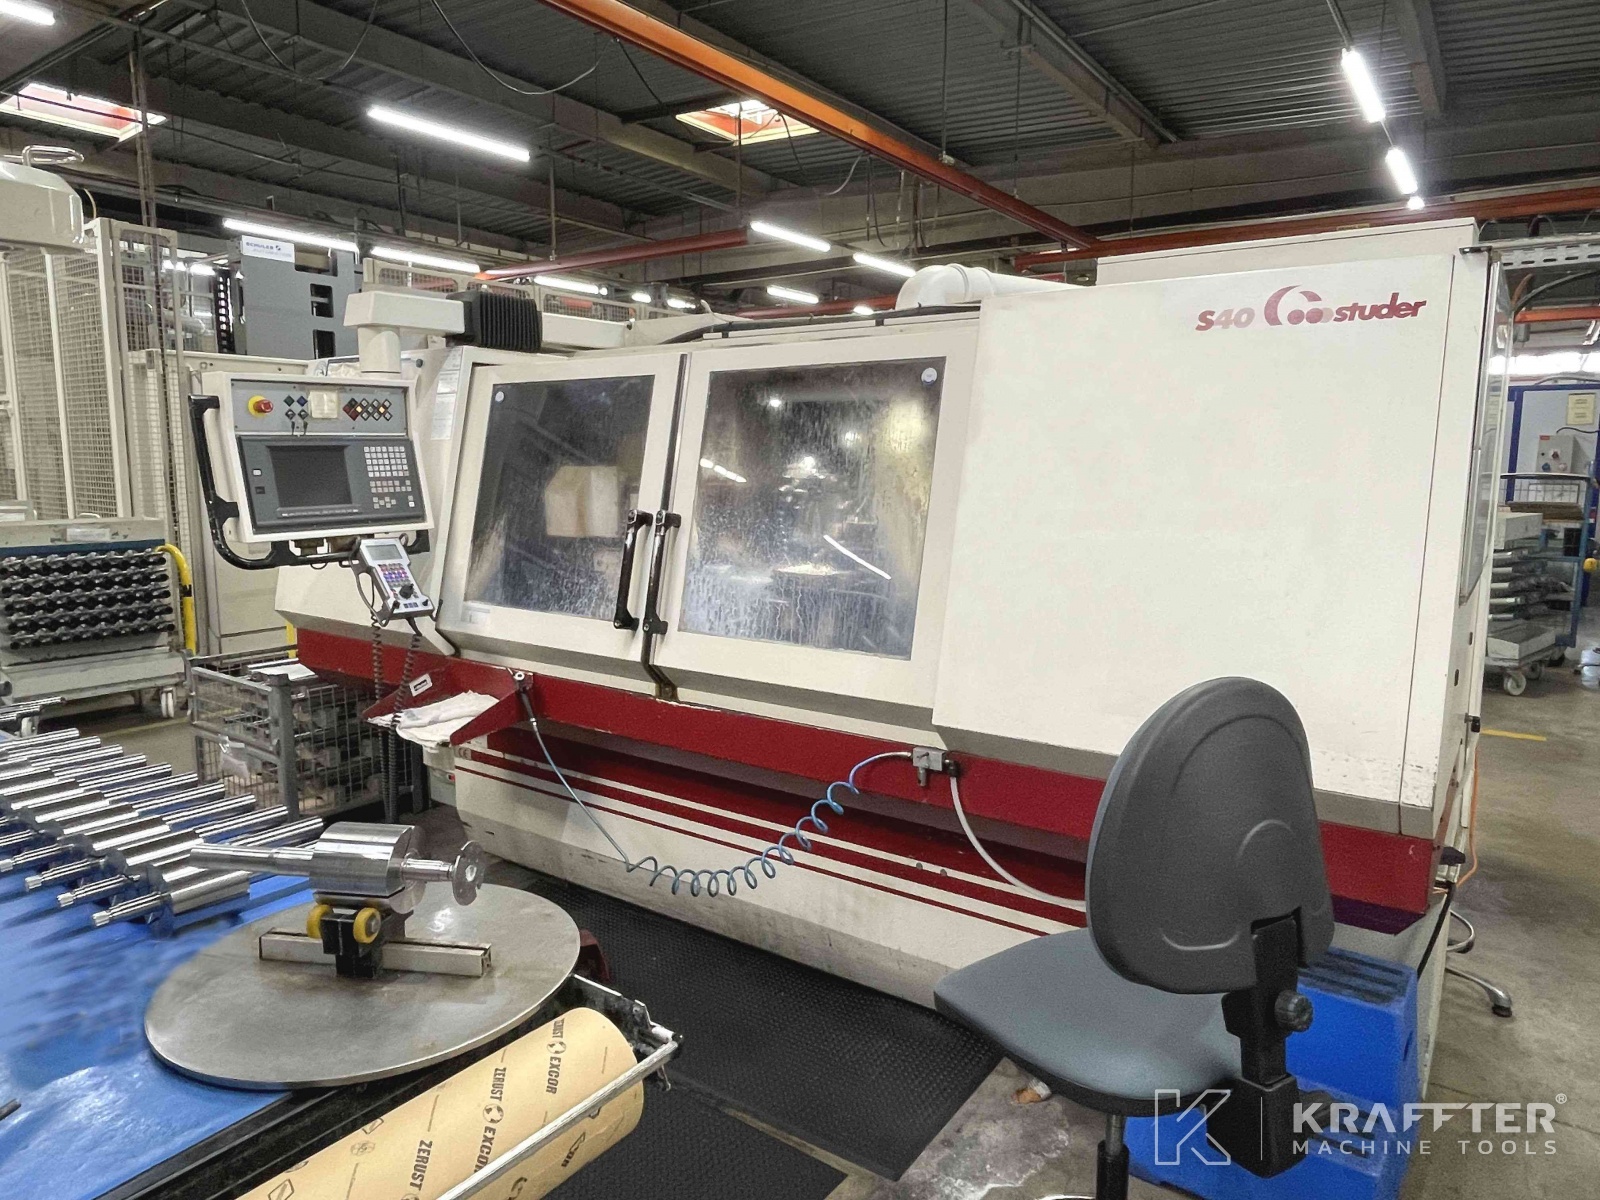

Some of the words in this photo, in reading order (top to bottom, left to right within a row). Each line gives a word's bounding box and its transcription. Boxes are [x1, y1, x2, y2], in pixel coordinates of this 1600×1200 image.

[1195, 307, 1256, 332] S40
[1333, 292, 1427, 323] studer
[490, 1067, 507, 1102] ZERUST
[545, 1056, 562, 1095] EXCOR
[409, 1139, 433, 1192] ZERUST
